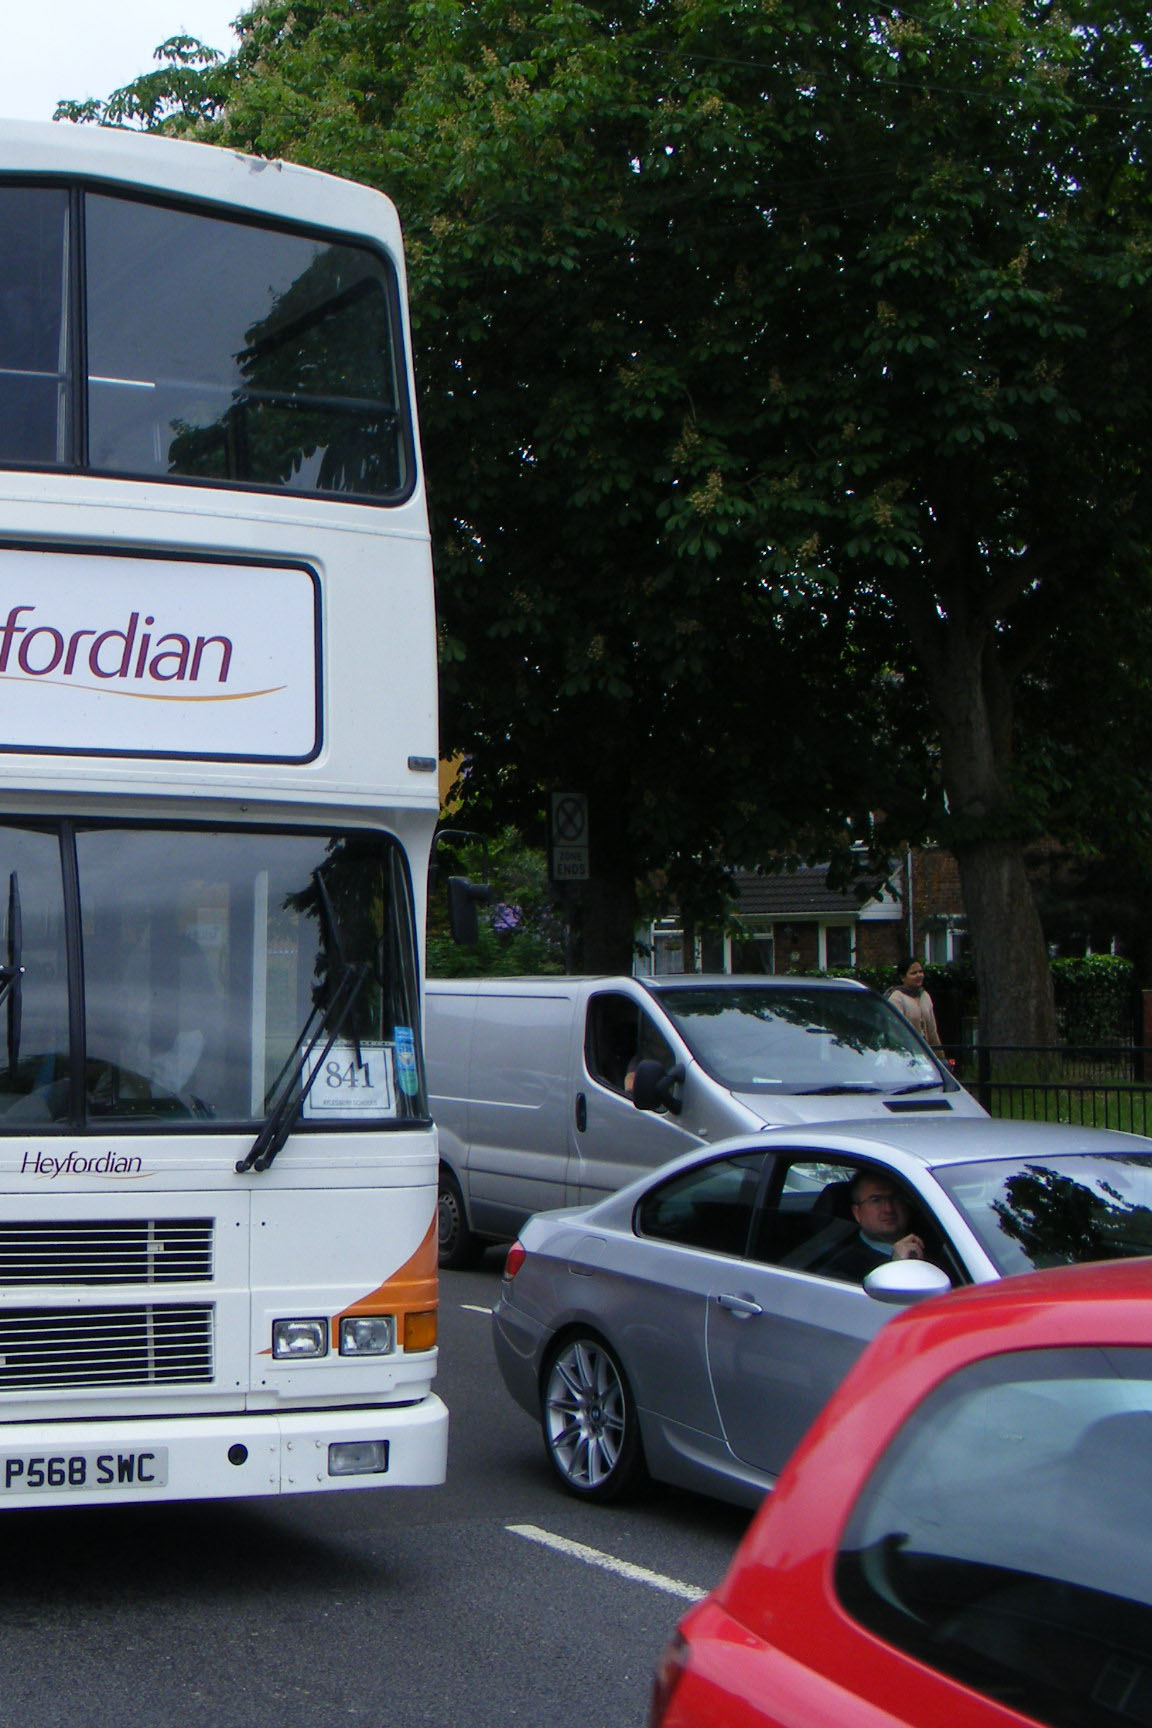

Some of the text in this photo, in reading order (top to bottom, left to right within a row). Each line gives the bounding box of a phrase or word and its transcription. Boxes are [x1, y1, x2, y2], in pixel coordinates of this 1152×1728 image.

[557, 863, 586, 875] ENDS
[559, 851, 583, 862] ZONE
[325, 1061, 374, 1089] 841
[20, 1150, 142, 1180] Heyfordian
[5, 1453, 155, 1488] P568 SWC
